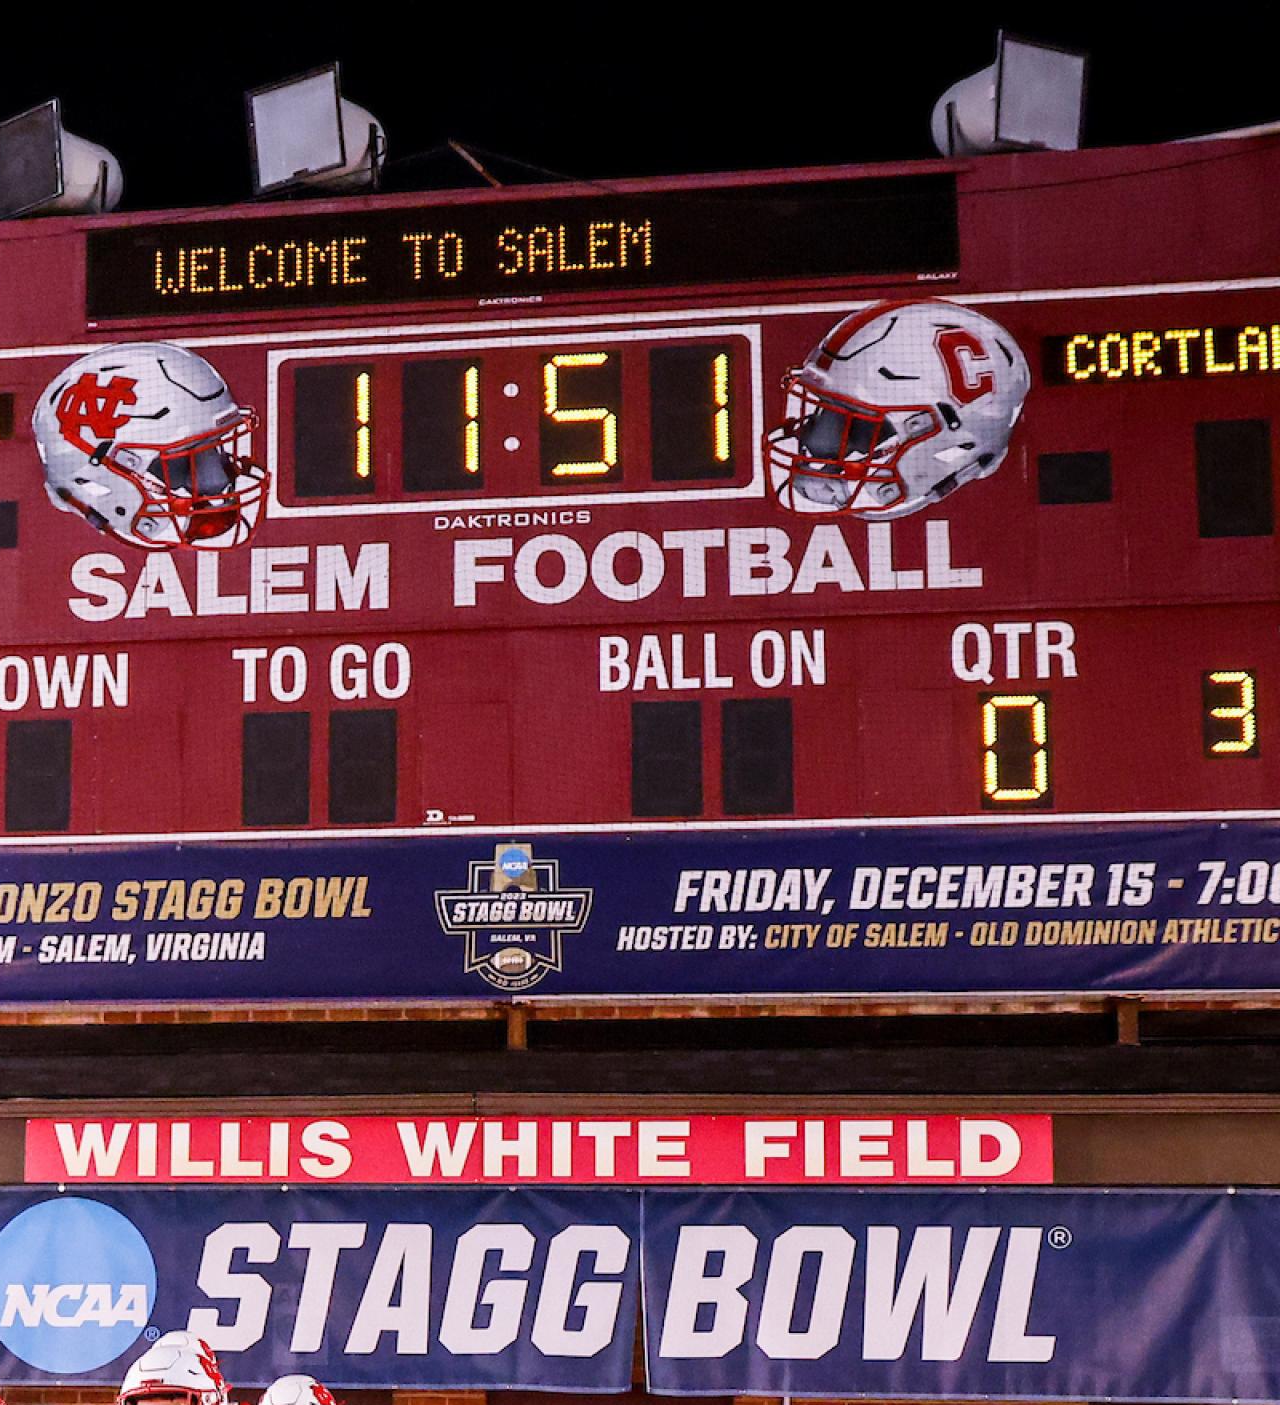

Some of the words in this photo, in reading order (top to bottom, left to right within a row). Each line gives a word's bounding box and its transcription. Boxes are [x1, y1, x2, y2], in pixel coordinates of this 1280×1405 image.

[155, 237, 367, 295] WELCOME
[402, 231, 464, 282] TO
[497, 219, 653, 276] SALEM
[1067, 325, 1280, 379] CORTLA
[356, 352, 730, 478] 11:51
[434, 510, 591, 530] DAKTRONICS
[67, 542, 389, 623] SALEM
[453, 519, 983, 606] FOOTBALL
[232, 646, 308, 704] TO
[328, 642, 411, 700] GO
[599, 632, 733, 692] BALL
[749, 628, 825, 688] ON
[951, 621, 1078, 684] QTR
[1209, 670, 1256, 753] 3
[983, 694, 1047, 801] 0
[111, 878, 243, 922] STAGG
[253, 876, 371, 920] BOWL
[452, 901, 517, 923] STAGG
[519, 900, 576, 922] BOWL
[675, 867, 836, 916] FRIDAY,
[848, 863, 1095, 910] DECEMBER
[1106, 863, 1156, 907] 15
[38, 933, 137, 965] SALEM,
[144, 931, 265, 962] VIRGINIA
[616, 926, 712, 951] HOSTED
[718, 925, 759, 951] BY:
[764, 923, 819, 949] CITY
[825, 922, 857, 947] OF
[862, 921, 946, 948] SALEM
[969, 920, 1018, 947] OLD
[1024, 919, 1157, 946] DOMINION
[54, 1120, 353, 1179] WILLIS
[397, 1120, 692, 1178] WHITE
[744, 1120, 1022, 1177] FIELD
[0, 1284, 149, 1328] NCAA
[186, 1221, 631, 1358] STAGG
[659, 1225, 1058, 1363] BOWL
